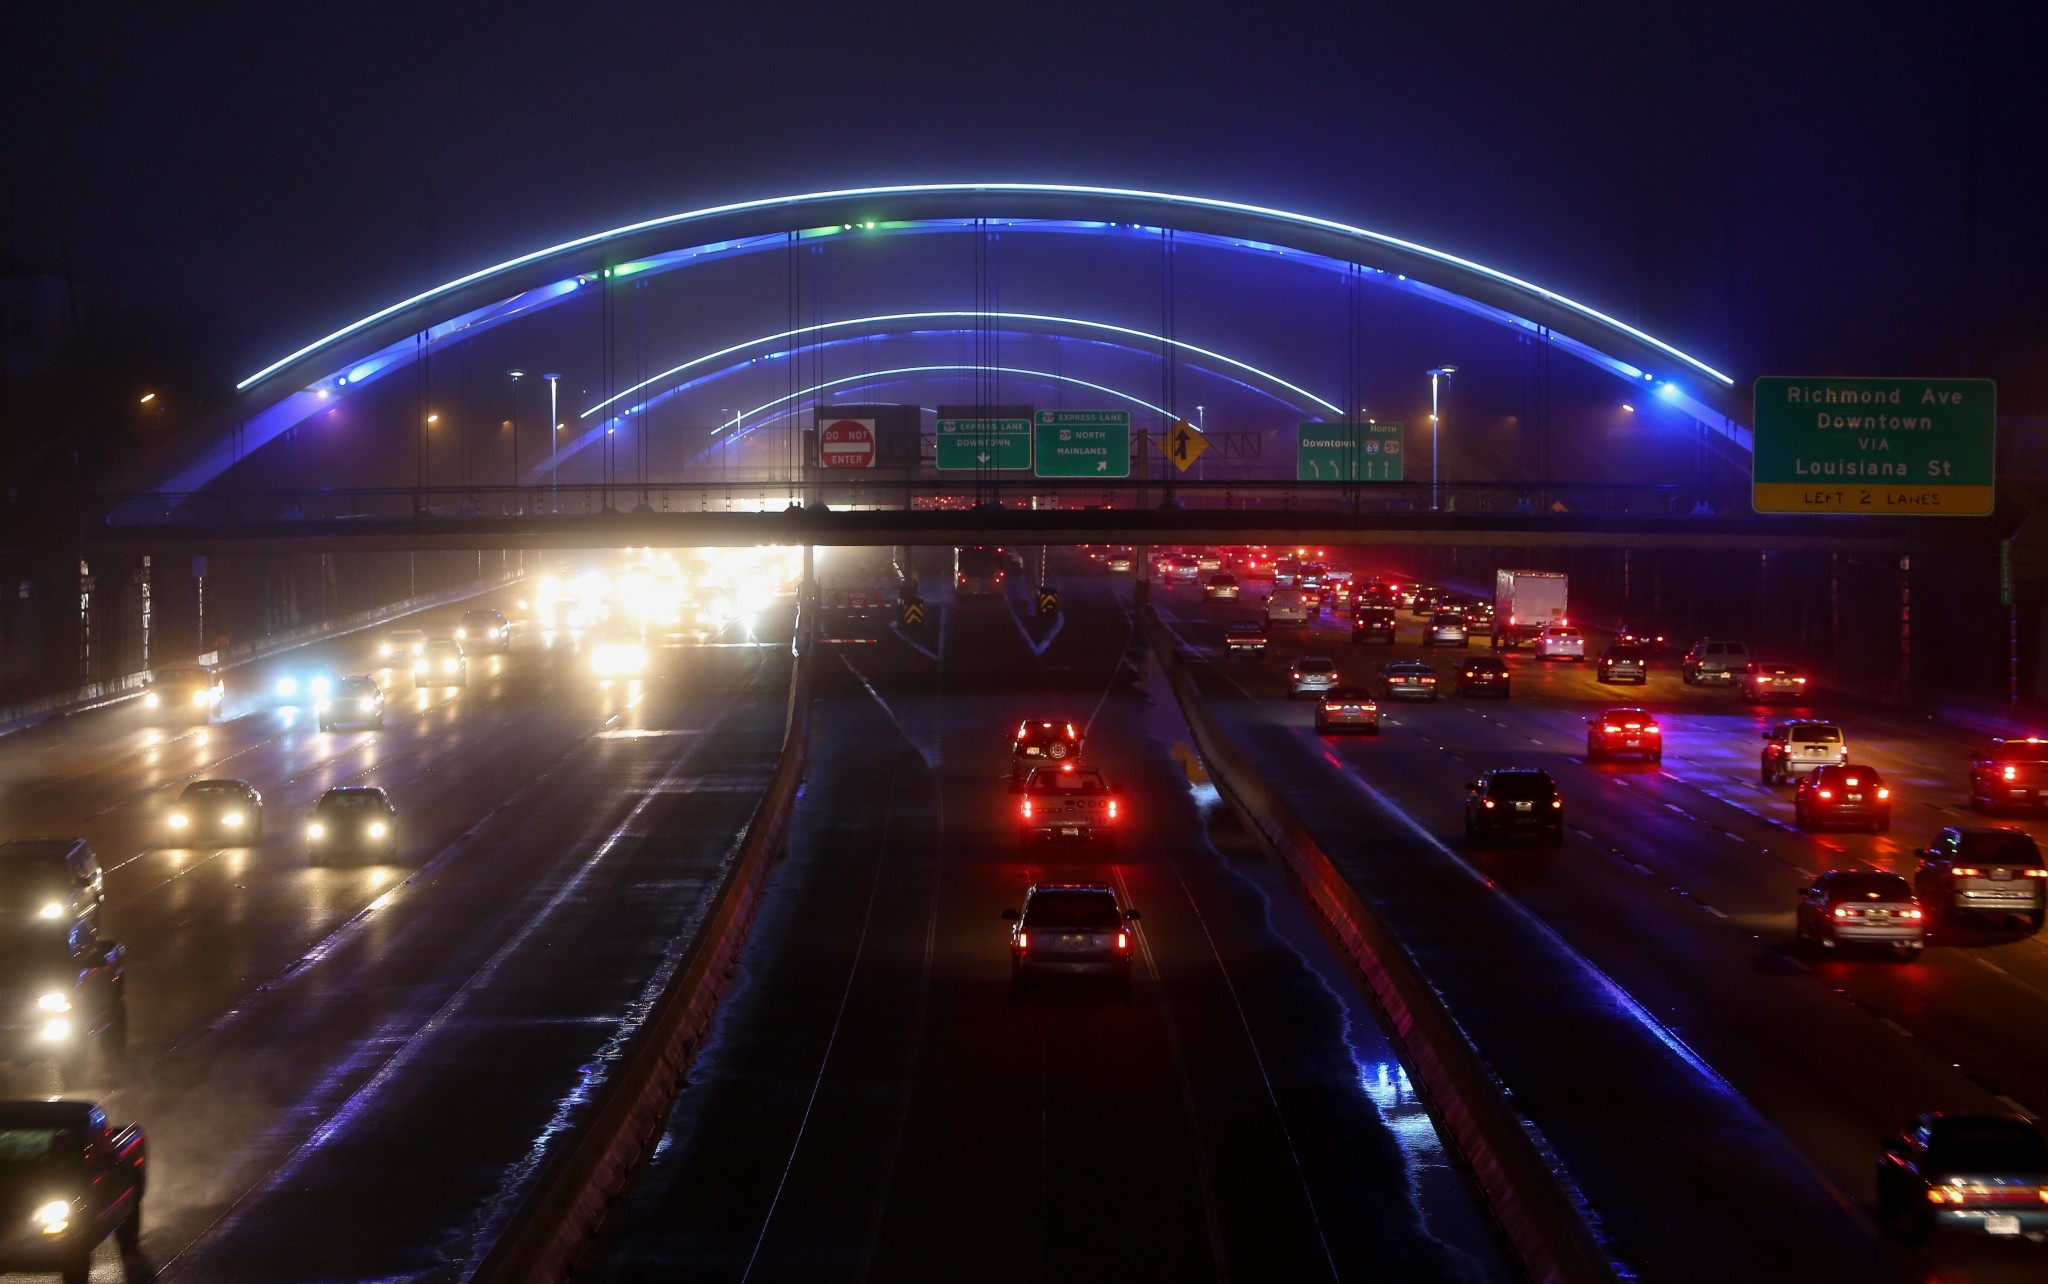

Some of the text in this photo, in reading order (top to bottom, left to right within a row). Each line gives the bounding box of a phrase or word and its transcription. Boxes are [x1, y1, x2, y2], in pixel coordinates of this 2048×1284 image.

[1787, 386, 1963, 405] Richmond Ave
[1818, 412, 1932, 430] Downtown
[825, 430, 868, 440] DO NOT
[1075, 431, 1106, 439] NORTH
[1302, 439, 1356, 448] Downtown
[1366, 443, 1379, 452] 69
[1385, 443, 1398, 452] 59
[1858, 438, 1890, 450] VIA
[1057, 447, 1107, 455] MAINLANES
[832, 455, 862, 464] ENTER
[1796, 459, 1952, 477] Louisiana St
[1804, 490, 1941, 505] LEFT 2 LANES
